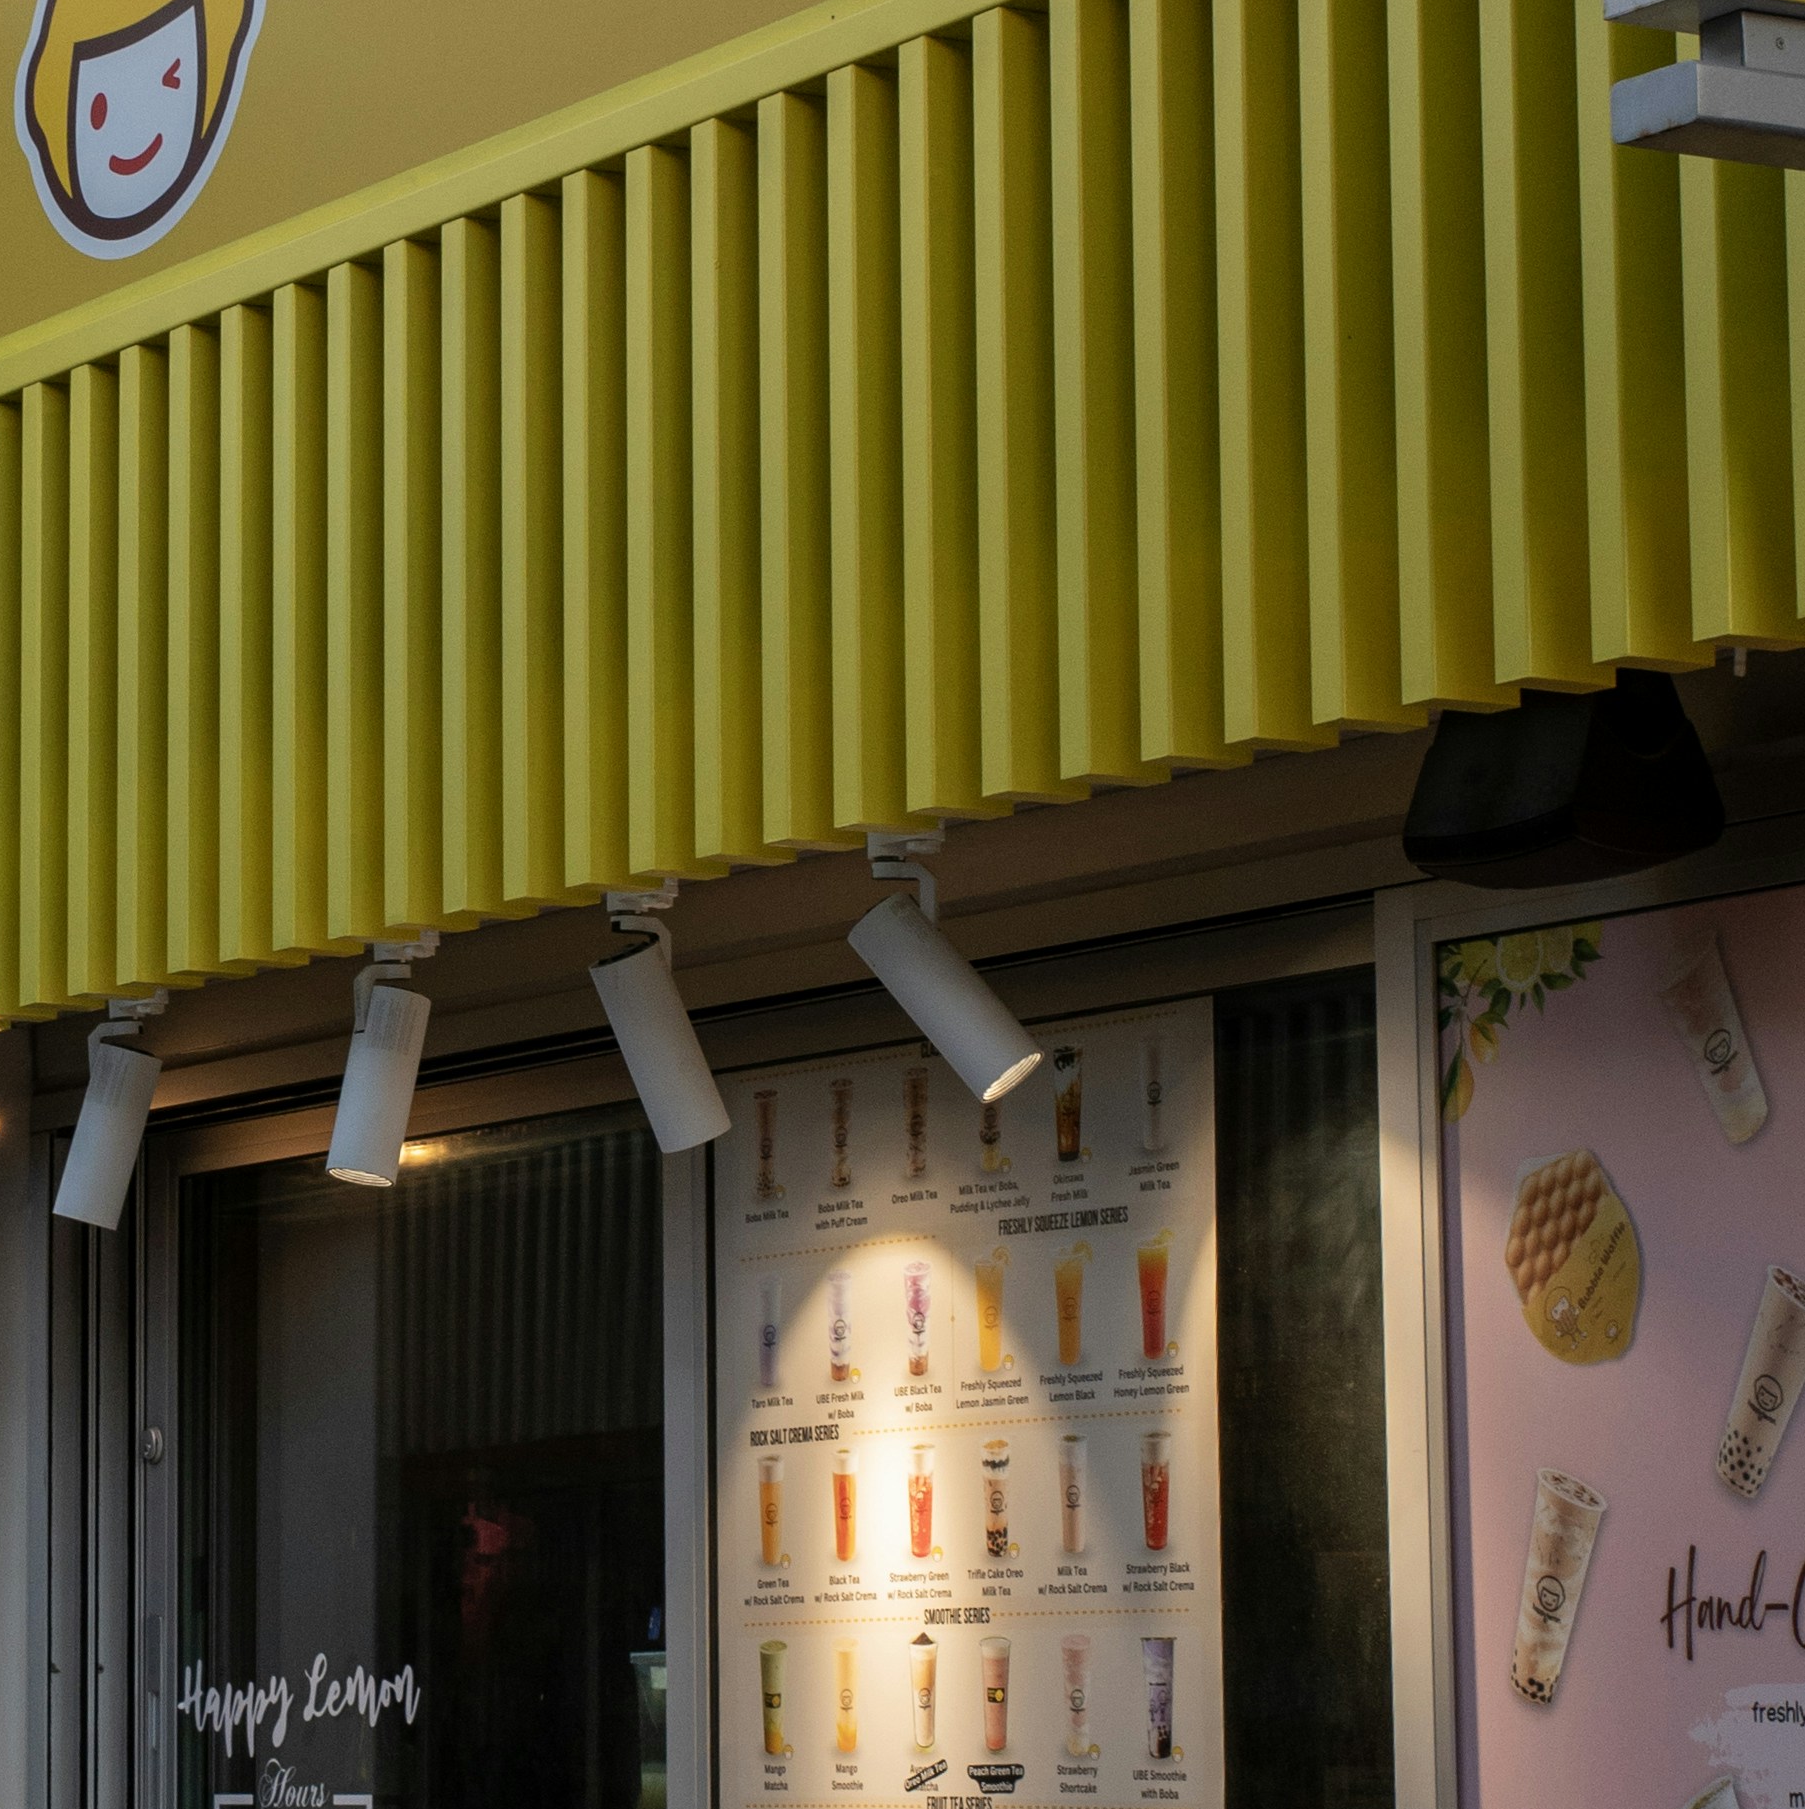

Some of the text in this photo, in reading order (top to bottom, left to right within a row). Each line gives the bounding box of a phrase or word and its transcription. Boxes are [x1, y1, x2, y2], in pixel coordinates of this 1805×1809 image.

[818, 1199, 863, 1214] Boba Milk Tea
[745, 1209, 789, 1224] Boba Milk Tea
[815, 1215, 868, 1230] with Puff Cream
[999, 1206, 1128, 1236] FRESHLY SQUEEZE LEMON SERIES
[750, 1424, 839, 1446] ROCK SALT CREMA SERIES
[1660, 1544, 1805, 1661] Hand-
[924, 1607, 990, 1624] SMOOTHIE SERIES
[177, 1652, 420, 1758] Happy Lemon
